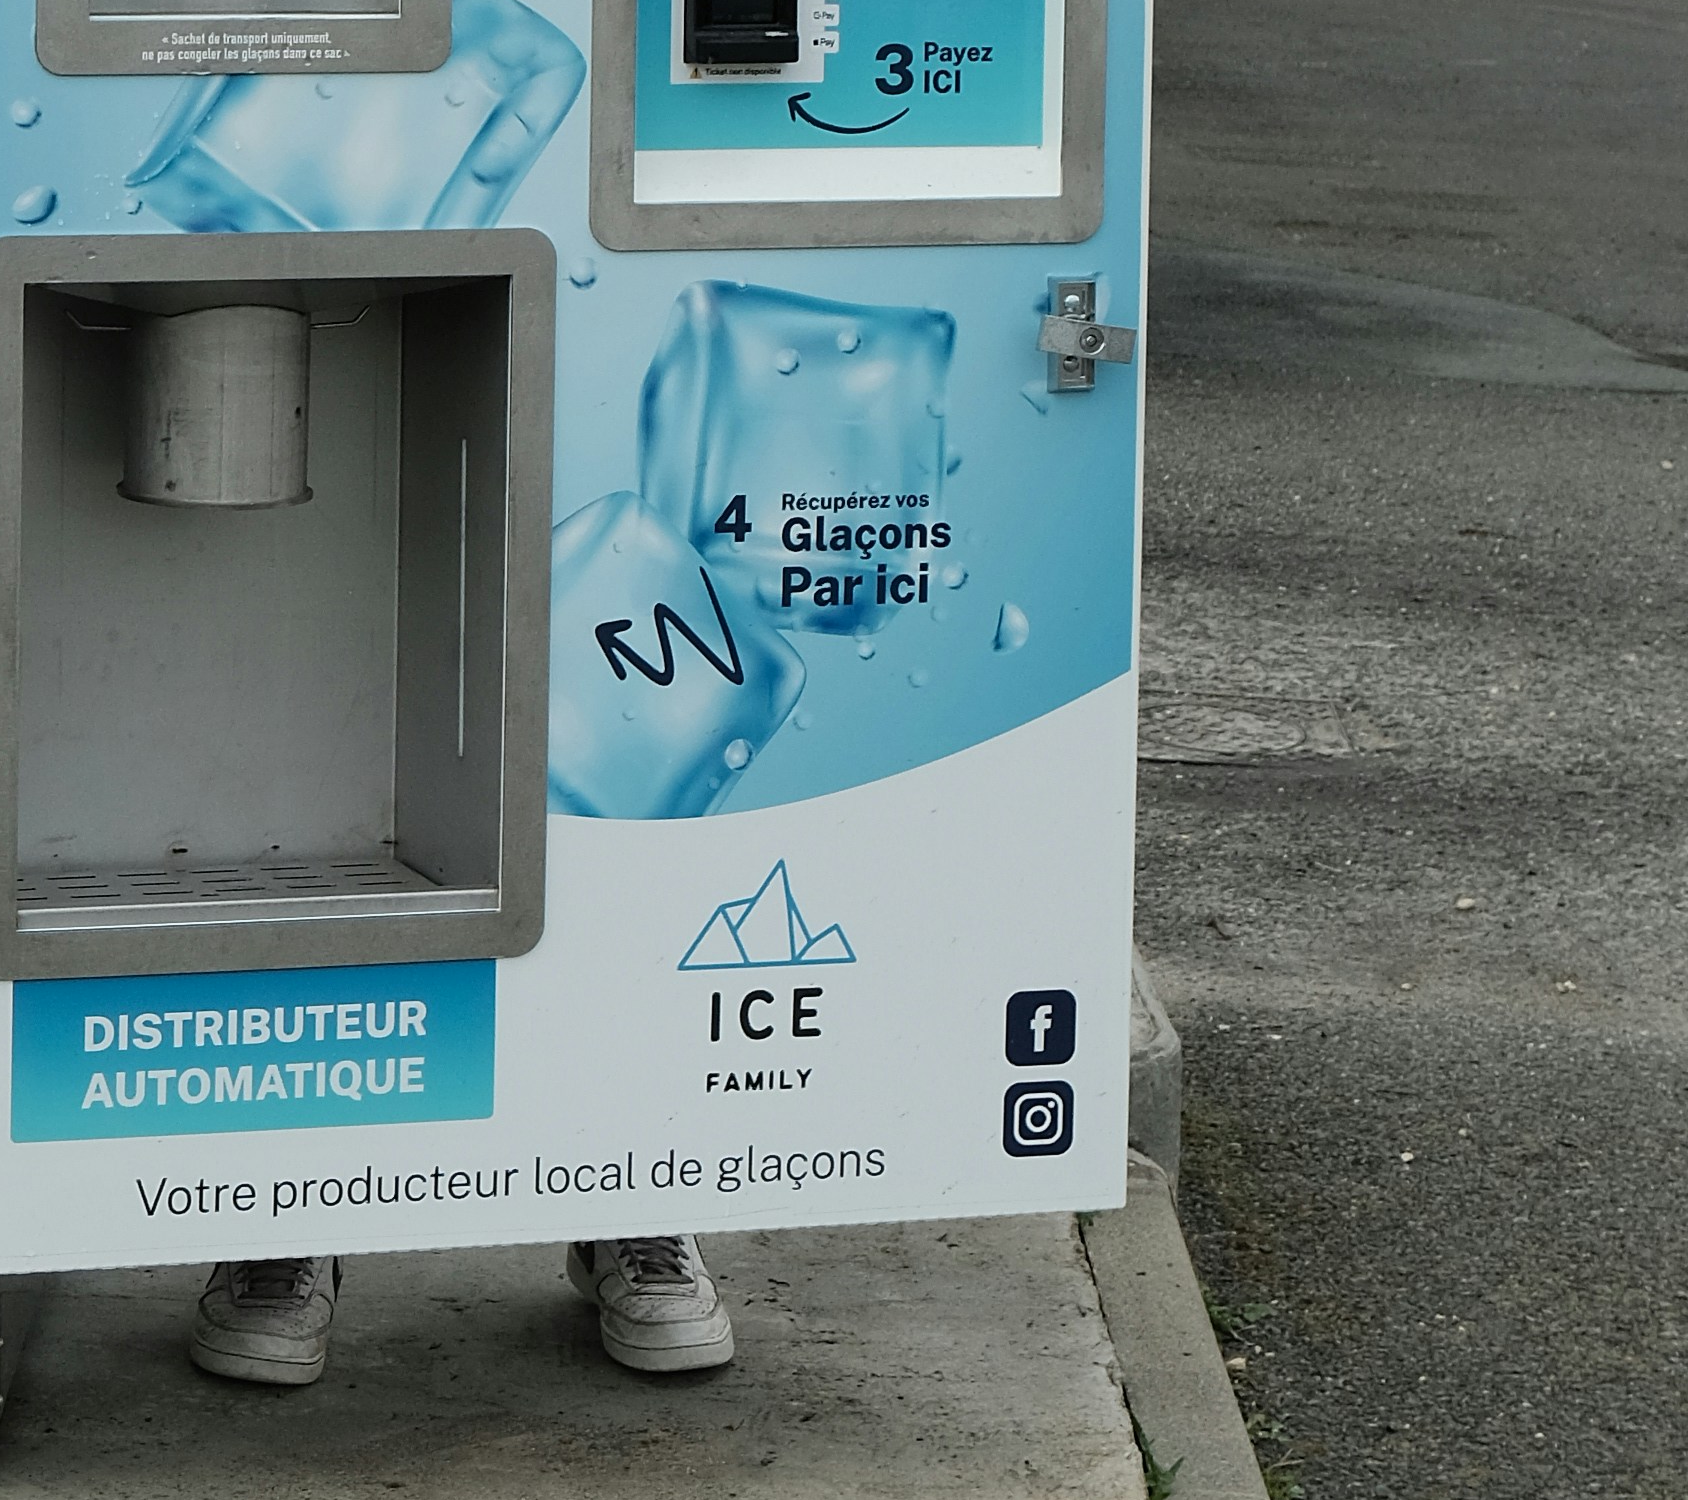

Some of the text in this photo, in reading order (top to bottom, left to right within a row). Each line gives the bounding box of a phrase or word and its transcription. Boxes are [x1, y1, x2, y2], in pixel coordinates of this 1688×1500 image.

[141, 50, 154, 61] ne
[156, 50, 175, 64] pas
[178, 47, 222, 63] congeler
[224, 47, 239, 60] les
[241, 47, 281, 63] glaçons
[309, 49, 322, 59] ce
[324, 49, 342, 59] sac
[171, 32, 206, 45] Sachet
[208, 32, 221, 45] de
[223, 32, 268, 47] transport
[924, 41, 994, 67] Payez
[874, 43, 915, 96] 3
[923, 68, 963, 94] ICI
[714, 494, 753, 543] 4
[781, 491, 931, 513] Récupérez vos
[781, 515, 952, 561] Glaçons
[780, 562, 930, 608] Par ici
[84, 1000, 427, 1053] DISTRIBUTEUR
[710, 987, 824, 1043] ICE
[81, 1056, 425, 1110] AUTOMATIQUE
[706, 1068, 813, 1093] FAMILY
[136, 1143, 886, 1218] Votre producteur local de glaçons
